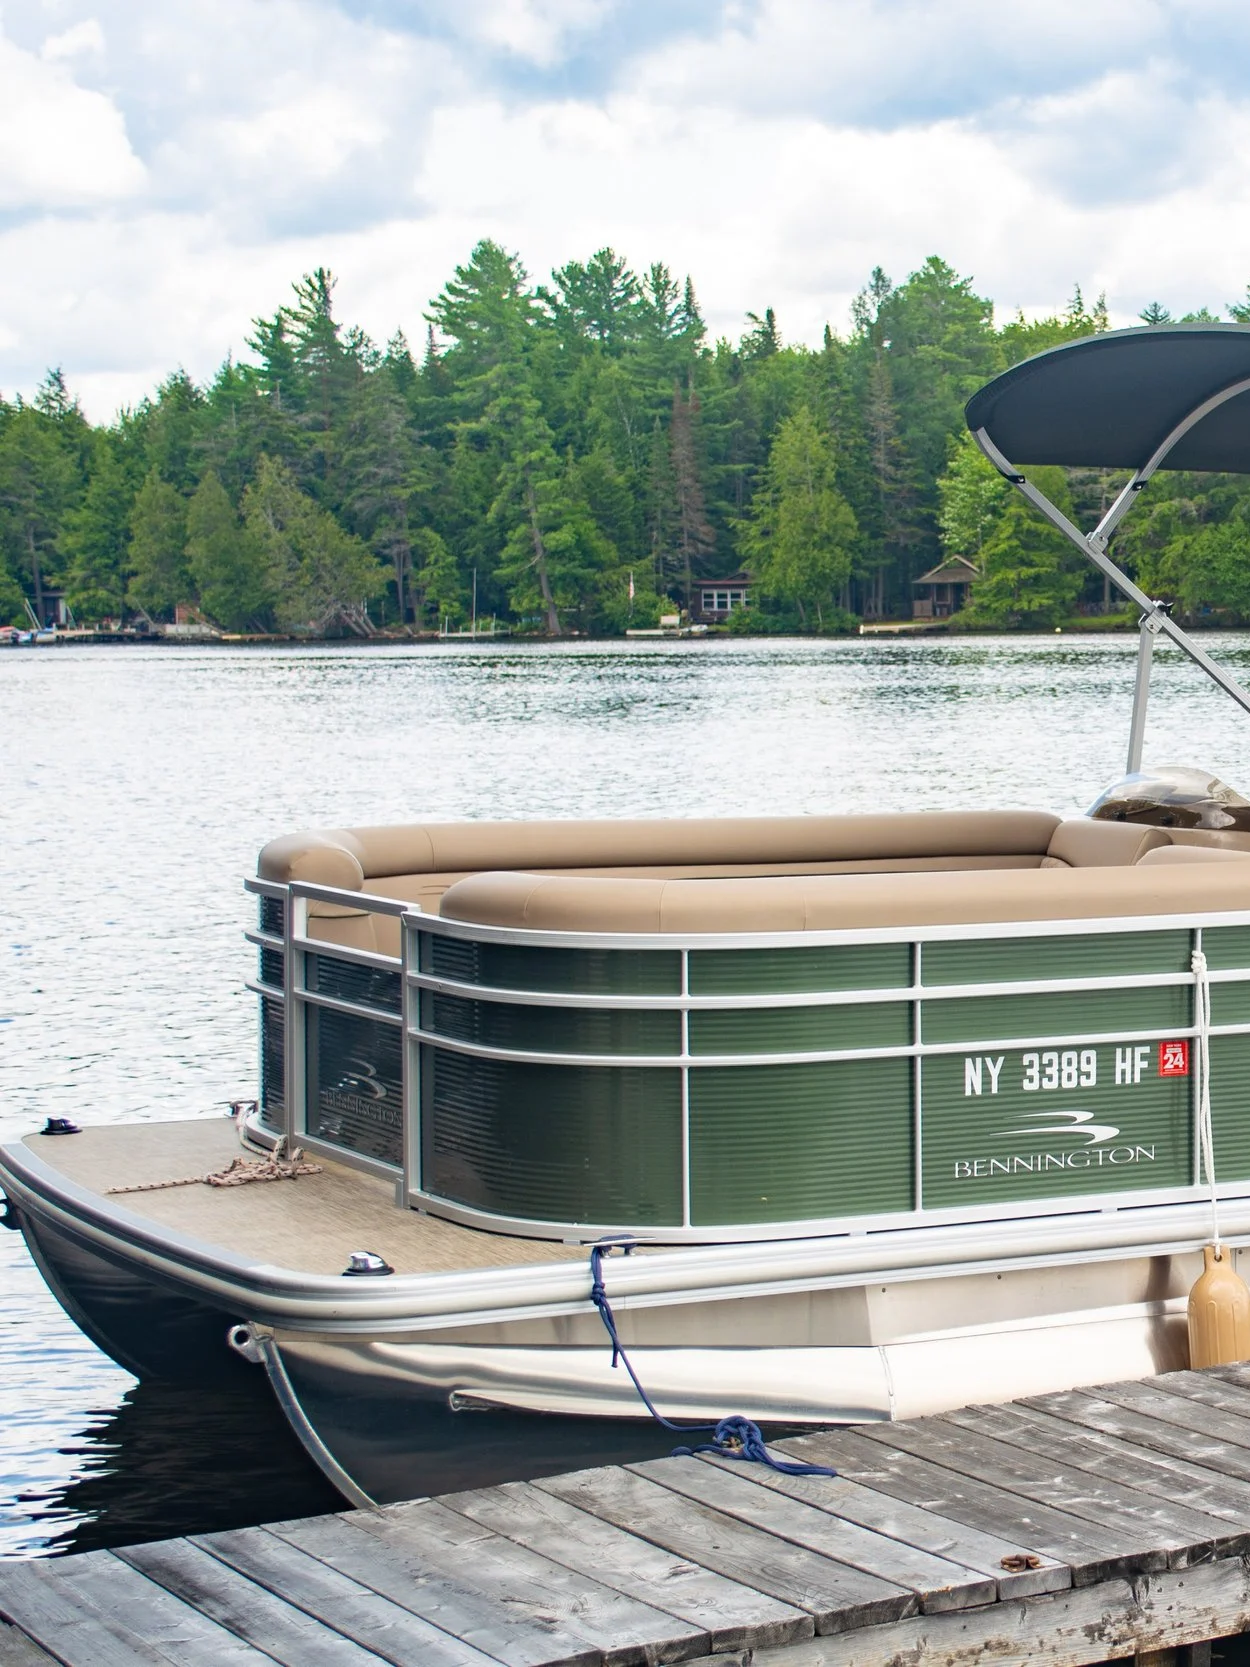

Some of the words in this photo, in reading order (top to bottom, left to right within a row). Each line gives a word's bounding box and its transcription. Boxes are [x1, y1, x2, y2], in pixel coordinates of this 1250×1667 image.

[964, 1056, 1005, 1096] NY
[1022, 1050, 1097, 1091] 3389
[1115, 1046, 1150, 1085] HF
[1163, 1052, 1185, 1070] 24
[954, 1145, 1155, 1179] BENNINGTON
